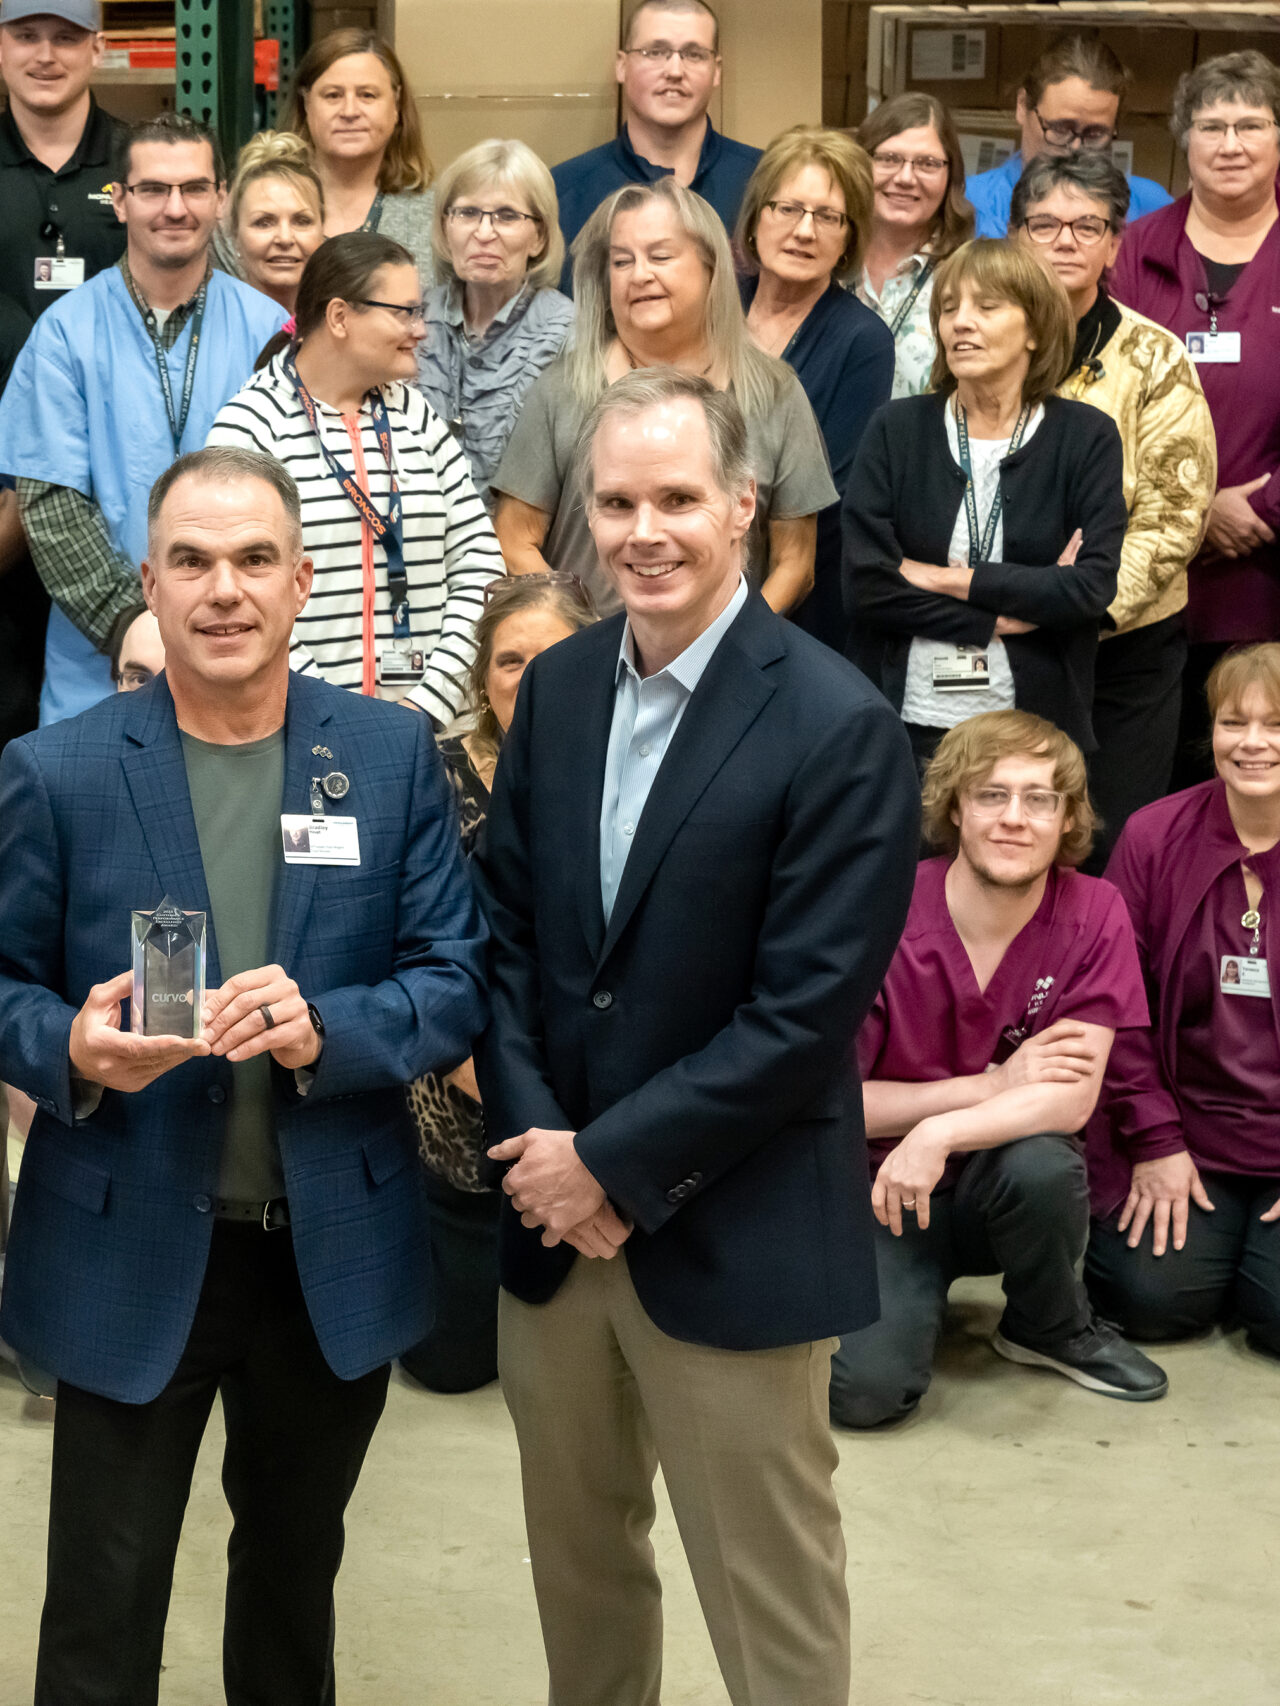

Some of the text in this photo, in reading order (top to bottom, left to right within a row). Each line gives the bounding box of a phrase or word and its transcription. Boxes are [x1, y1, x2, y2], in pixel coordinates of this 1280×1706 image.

[196, 286, 206, 315] EALTH
[184, 345, 198, 401] MONUMENT
[342, 479, 387, 536] BRONCOS
[151, 993, 188, 1003] curvo
